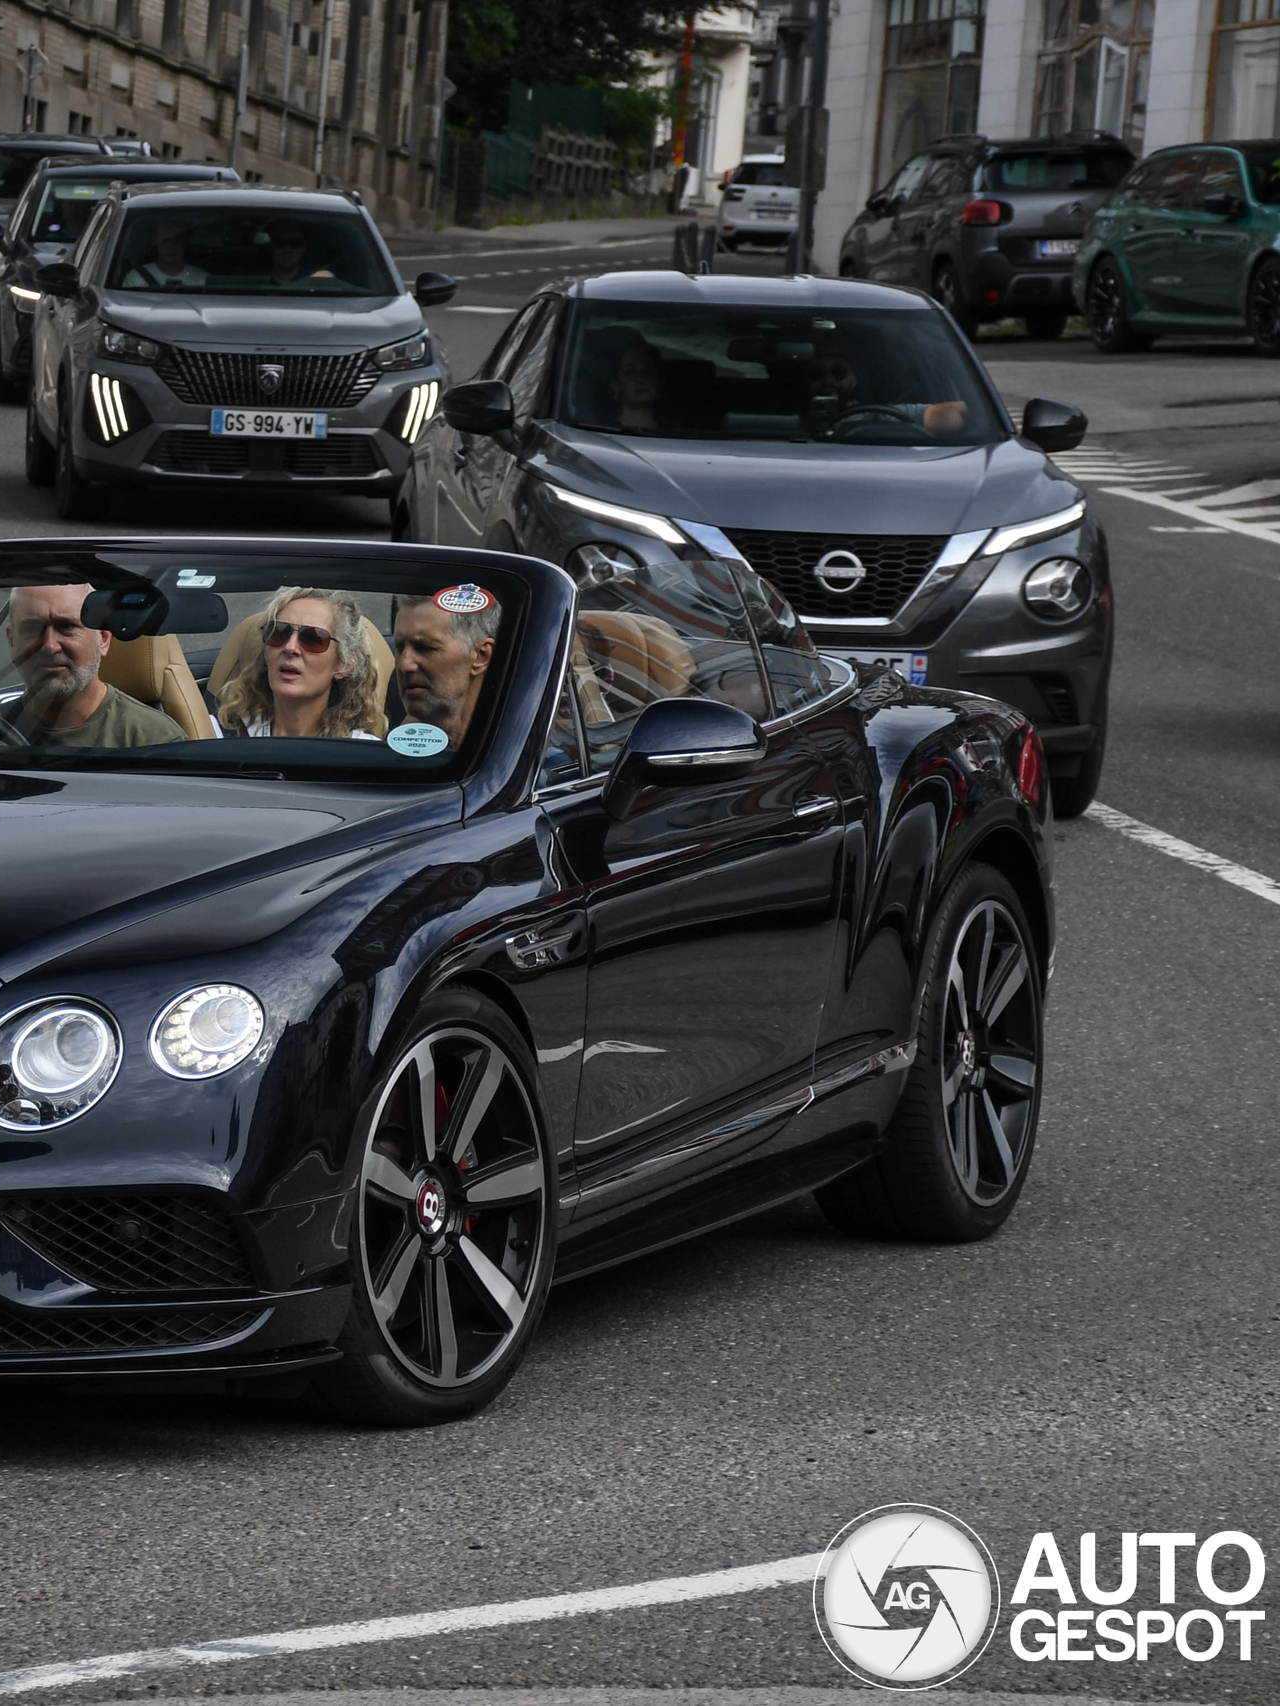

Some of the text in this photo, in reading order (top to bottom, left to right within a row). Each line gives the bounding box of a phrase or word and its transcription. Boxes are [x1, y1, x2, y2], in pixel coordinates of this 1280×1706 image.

[224, 413, 314, 435] GS-994-YW
[814, 568, 866, 577] NISSAN
[393, 736, 443, 744] COMPETITOR
[423, 1191, 439, 1221] B
